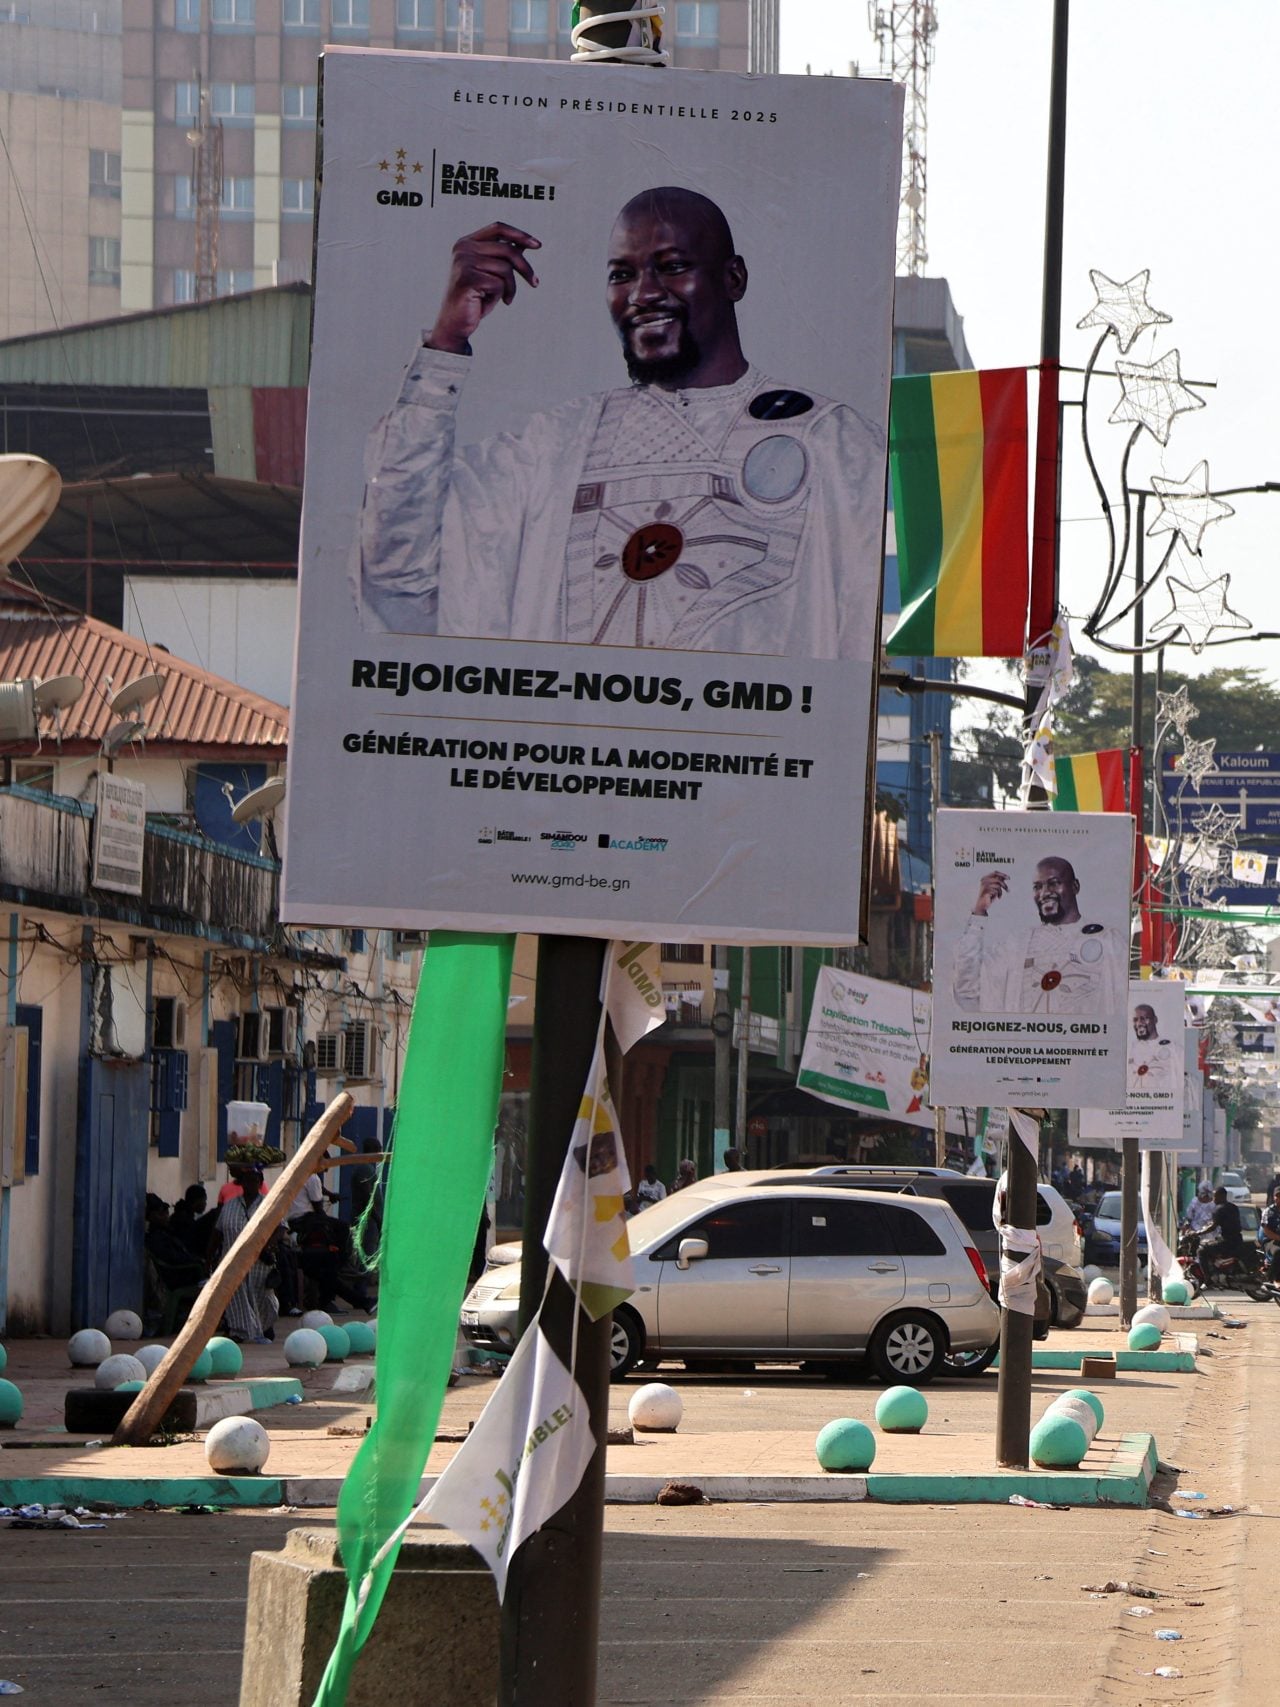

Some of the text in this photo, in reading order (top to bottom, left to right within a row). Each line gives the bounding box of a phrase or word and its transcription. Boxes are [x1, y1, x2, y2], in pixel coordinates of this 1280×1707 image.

[453, 90, 778, 124] ÉLECTION PRÉSIDENTIELLE 2025
[441, 160, 499, 182] BÂTIR
[441, 179, 545, 201] ENSEMBLE
[376, 190, 424, 207] GMD
[351, 659, 813, 714] REJOIGNEZ-NOUS, GMD !
[342, 733, 814, 779] GÉNÉRATION POUR LA MODERNITÉ ET
[1220, 756, 1270, 768] Kaloum
[450, 768, 702, 801] LE DÉVELOPPEMENT
[1255, 818, 1277, 826] DINAH
[540, 832, 588, 843] SIMANDOU
[609, 839, 668, 852] ACADEMY
[976, 851, 996, 859] BÂTIR
[511, 873, 631, 892] www.gmd-be.gn
[951, 1021, 1068, 1036] REJOIGNEZ-NOUS,
[1069, 1023, 1101, 1035] GMD
[949, 1045, 1109, 1057] GÉNÉRATION POUR LA MODERNITÉ ET
[985, 1055, 1072, 1066] LE DÉVELOPPEMENT
[1153, 1092, 1170, 1100] GMD
